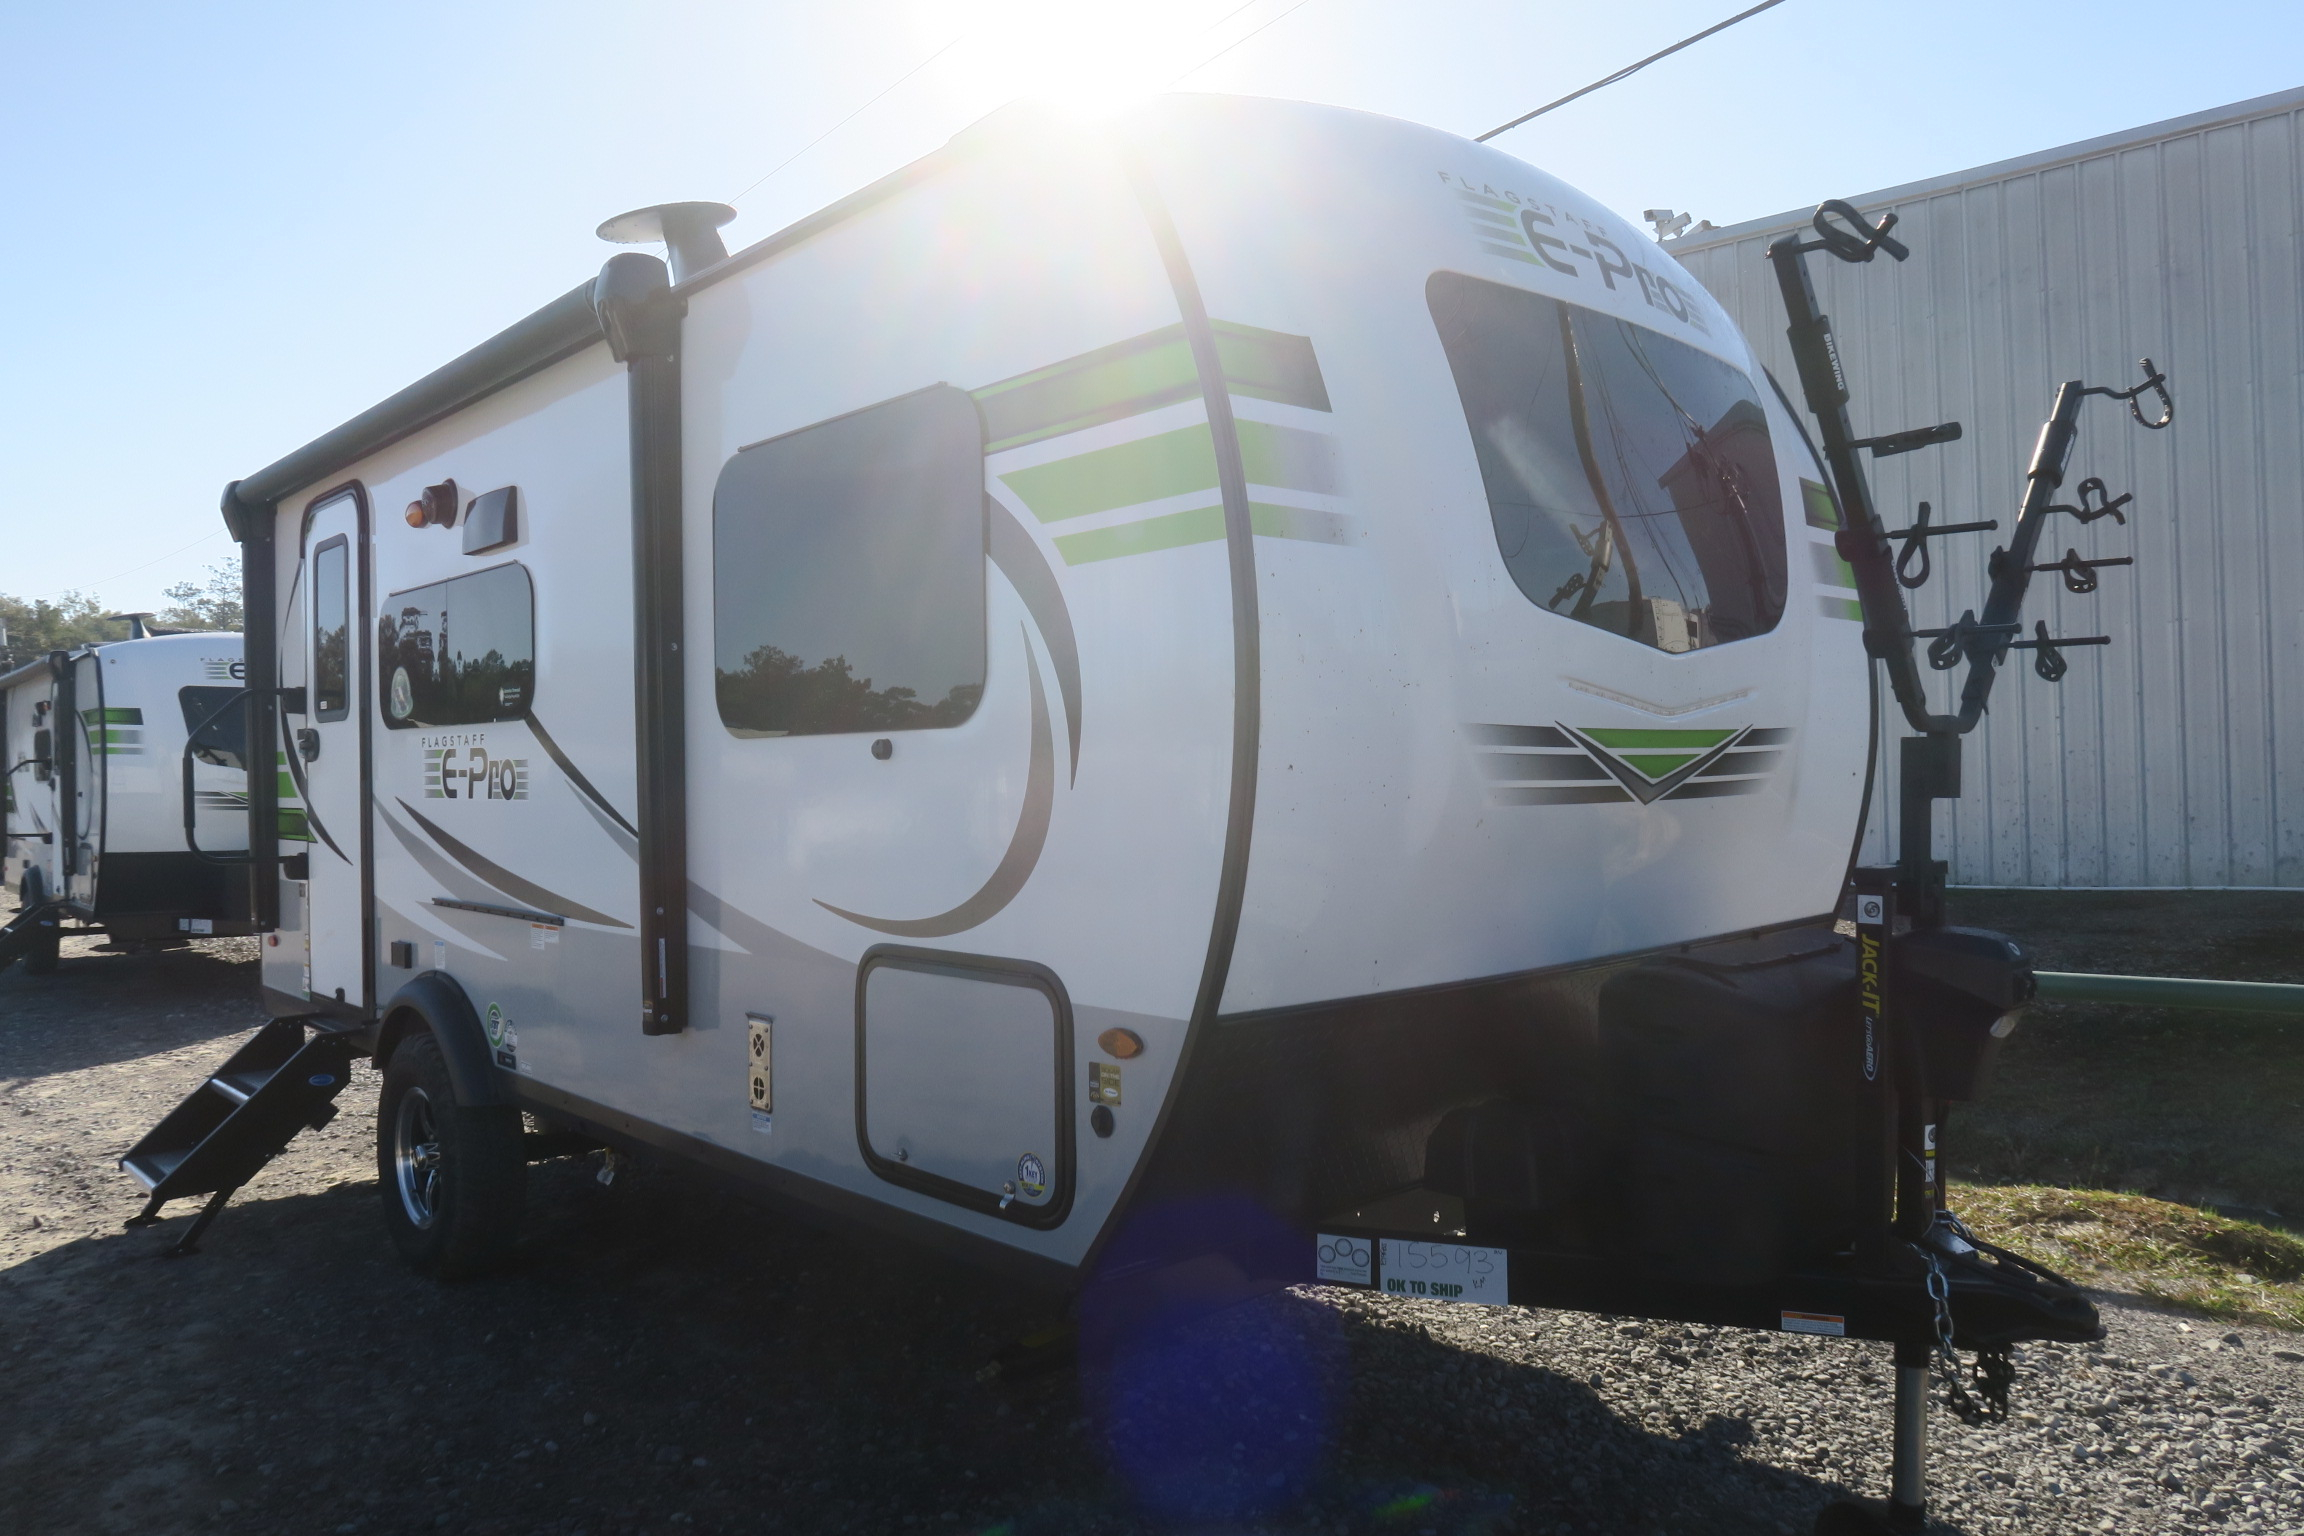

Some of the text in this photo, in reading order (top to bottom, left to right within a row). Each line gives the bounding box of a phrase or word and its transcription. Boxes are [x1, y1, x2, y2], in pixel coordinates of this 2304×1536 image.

[1438, 171, 1607, 237] FLAGSTAFF
[1823, 333, 1845, 390] BIKEWING
[421, 734, 485, 748] FLAGSTAFF
[1861, 933, 1880, 1015] JACK-IT
[1398, 1242, 1494, 1274] 15593
[1387, 1278, 1463, 1298] OK TO SHIP
